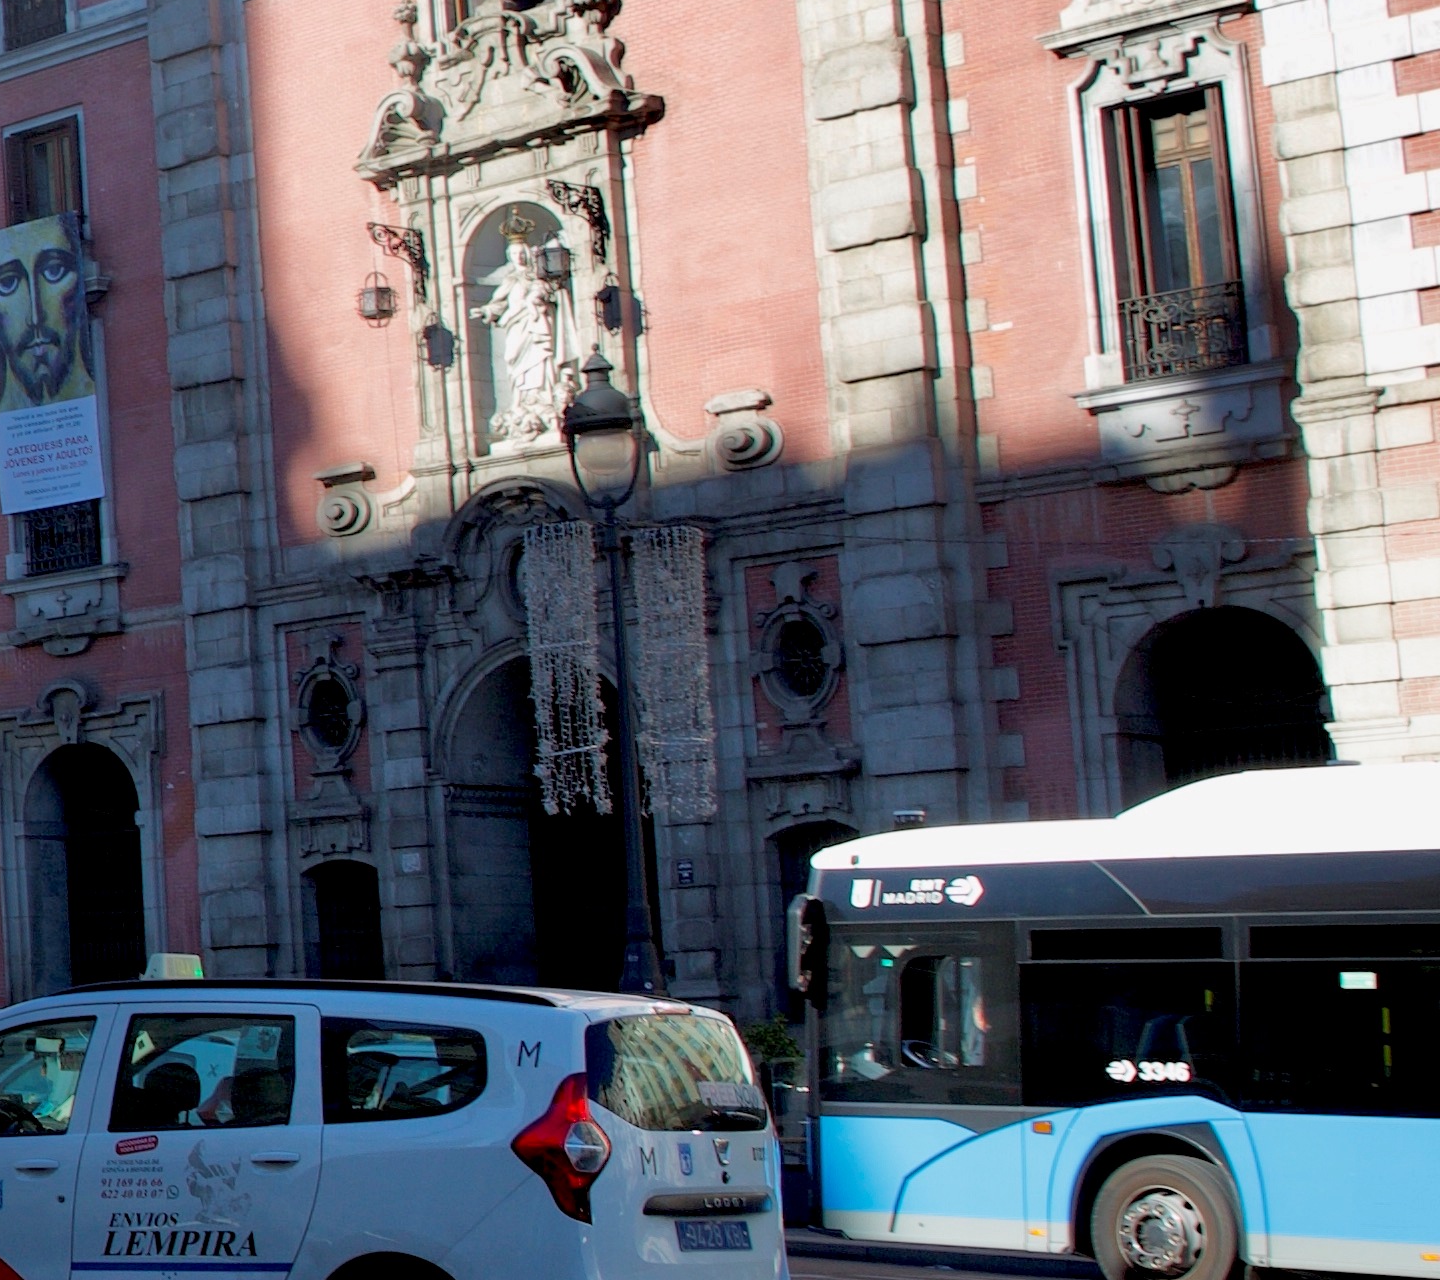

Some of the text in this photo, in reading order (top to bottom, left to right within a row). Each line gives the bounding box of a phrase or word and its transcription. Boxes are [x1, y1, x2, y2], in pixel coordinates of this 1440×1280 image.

[6, 434, 89, 456] CATEQUESIS PARA
[3, 445, 93, 469] JÓVENES Y ADULTOS
[910, 879, 946, 891] EMT
[882, 891, 943, 905] MADRID
[517, 1040, 542, 1068] M
[639, 1146, 657, 1176] M
[100, 1179, 112, 1187] 91
[101, 1189, 118, 1199] 622
[109, 1212, 179, 1228] ENVIOS
[101, 1230, 258, 1256] LEMPIRA
[688, 1225, 724, 1248] 9428
